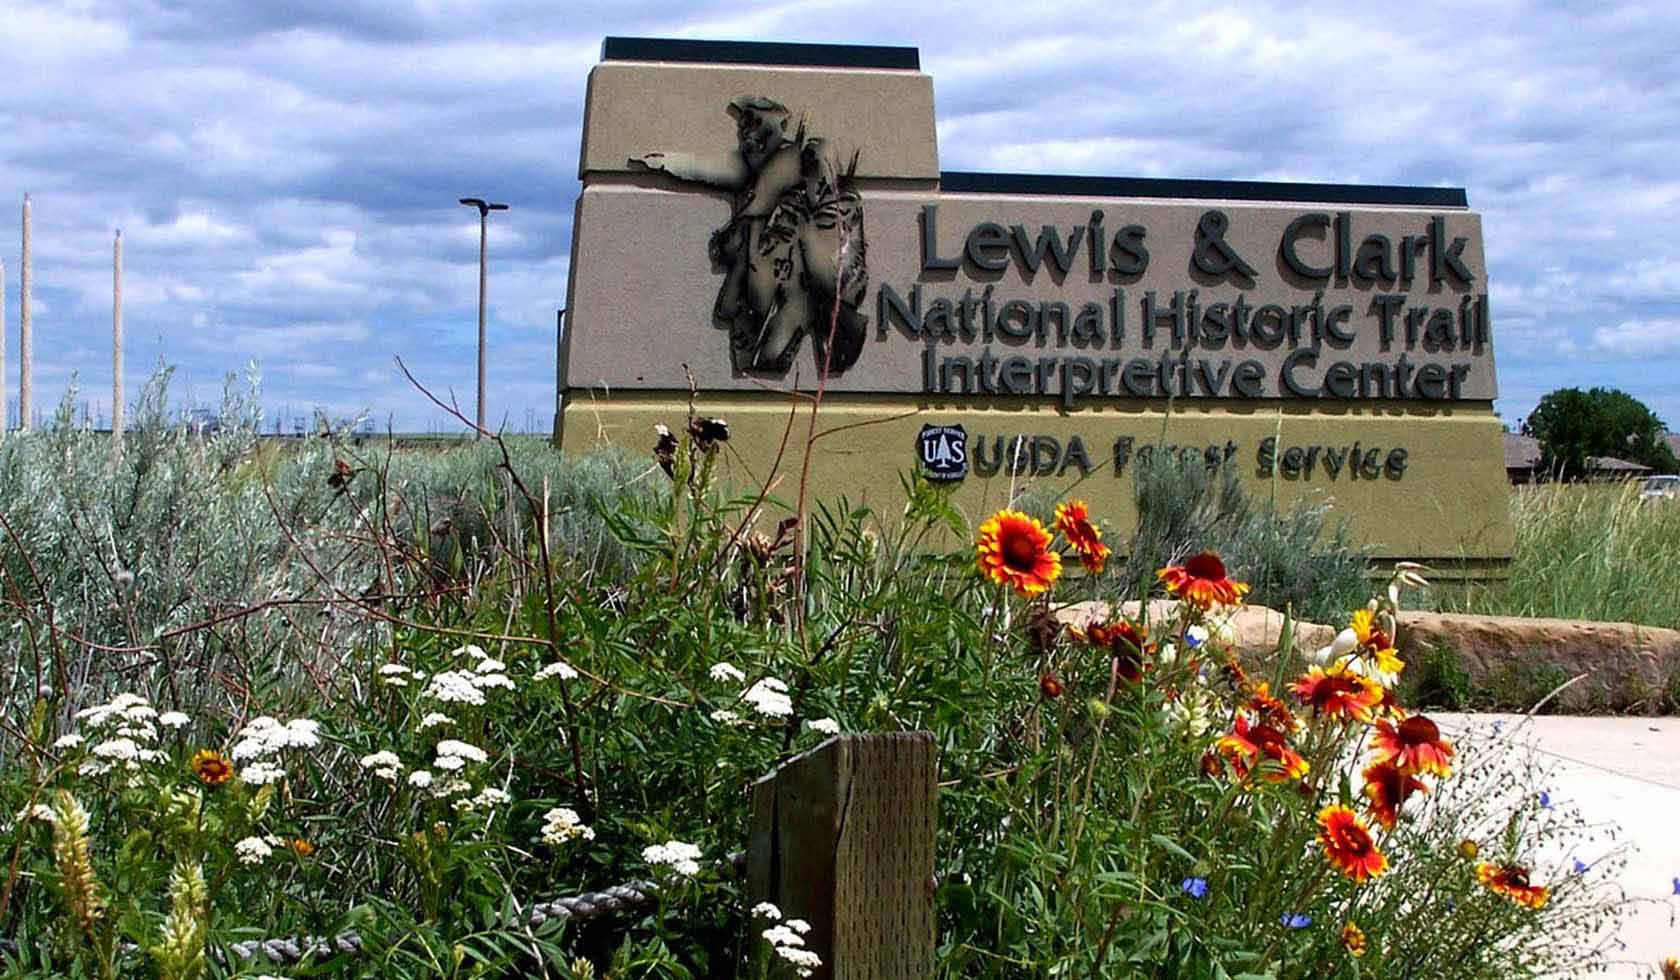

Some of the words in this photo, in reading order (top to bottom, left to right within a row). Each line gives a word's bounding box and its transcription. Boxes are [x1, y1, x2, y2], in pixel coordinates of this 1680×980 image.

[921, 203, 1150, 276] Lewis
[1192, 210, 1259, 276] &
[1281, 211, 1476, 282] Clark
[878, 282, 1127, 340] National
[1144, 288, 1357, 343] Historic
[1371, 294, 1489, 347] Trail
[923, 346, 1267, 408] Interpretive
[1281, 347, 1472, 399] Center
[974, 434, 1091, 474] USDA
[1113, 436, 1238, 473] Fost
[1256, 436, 1409, 477] Service
